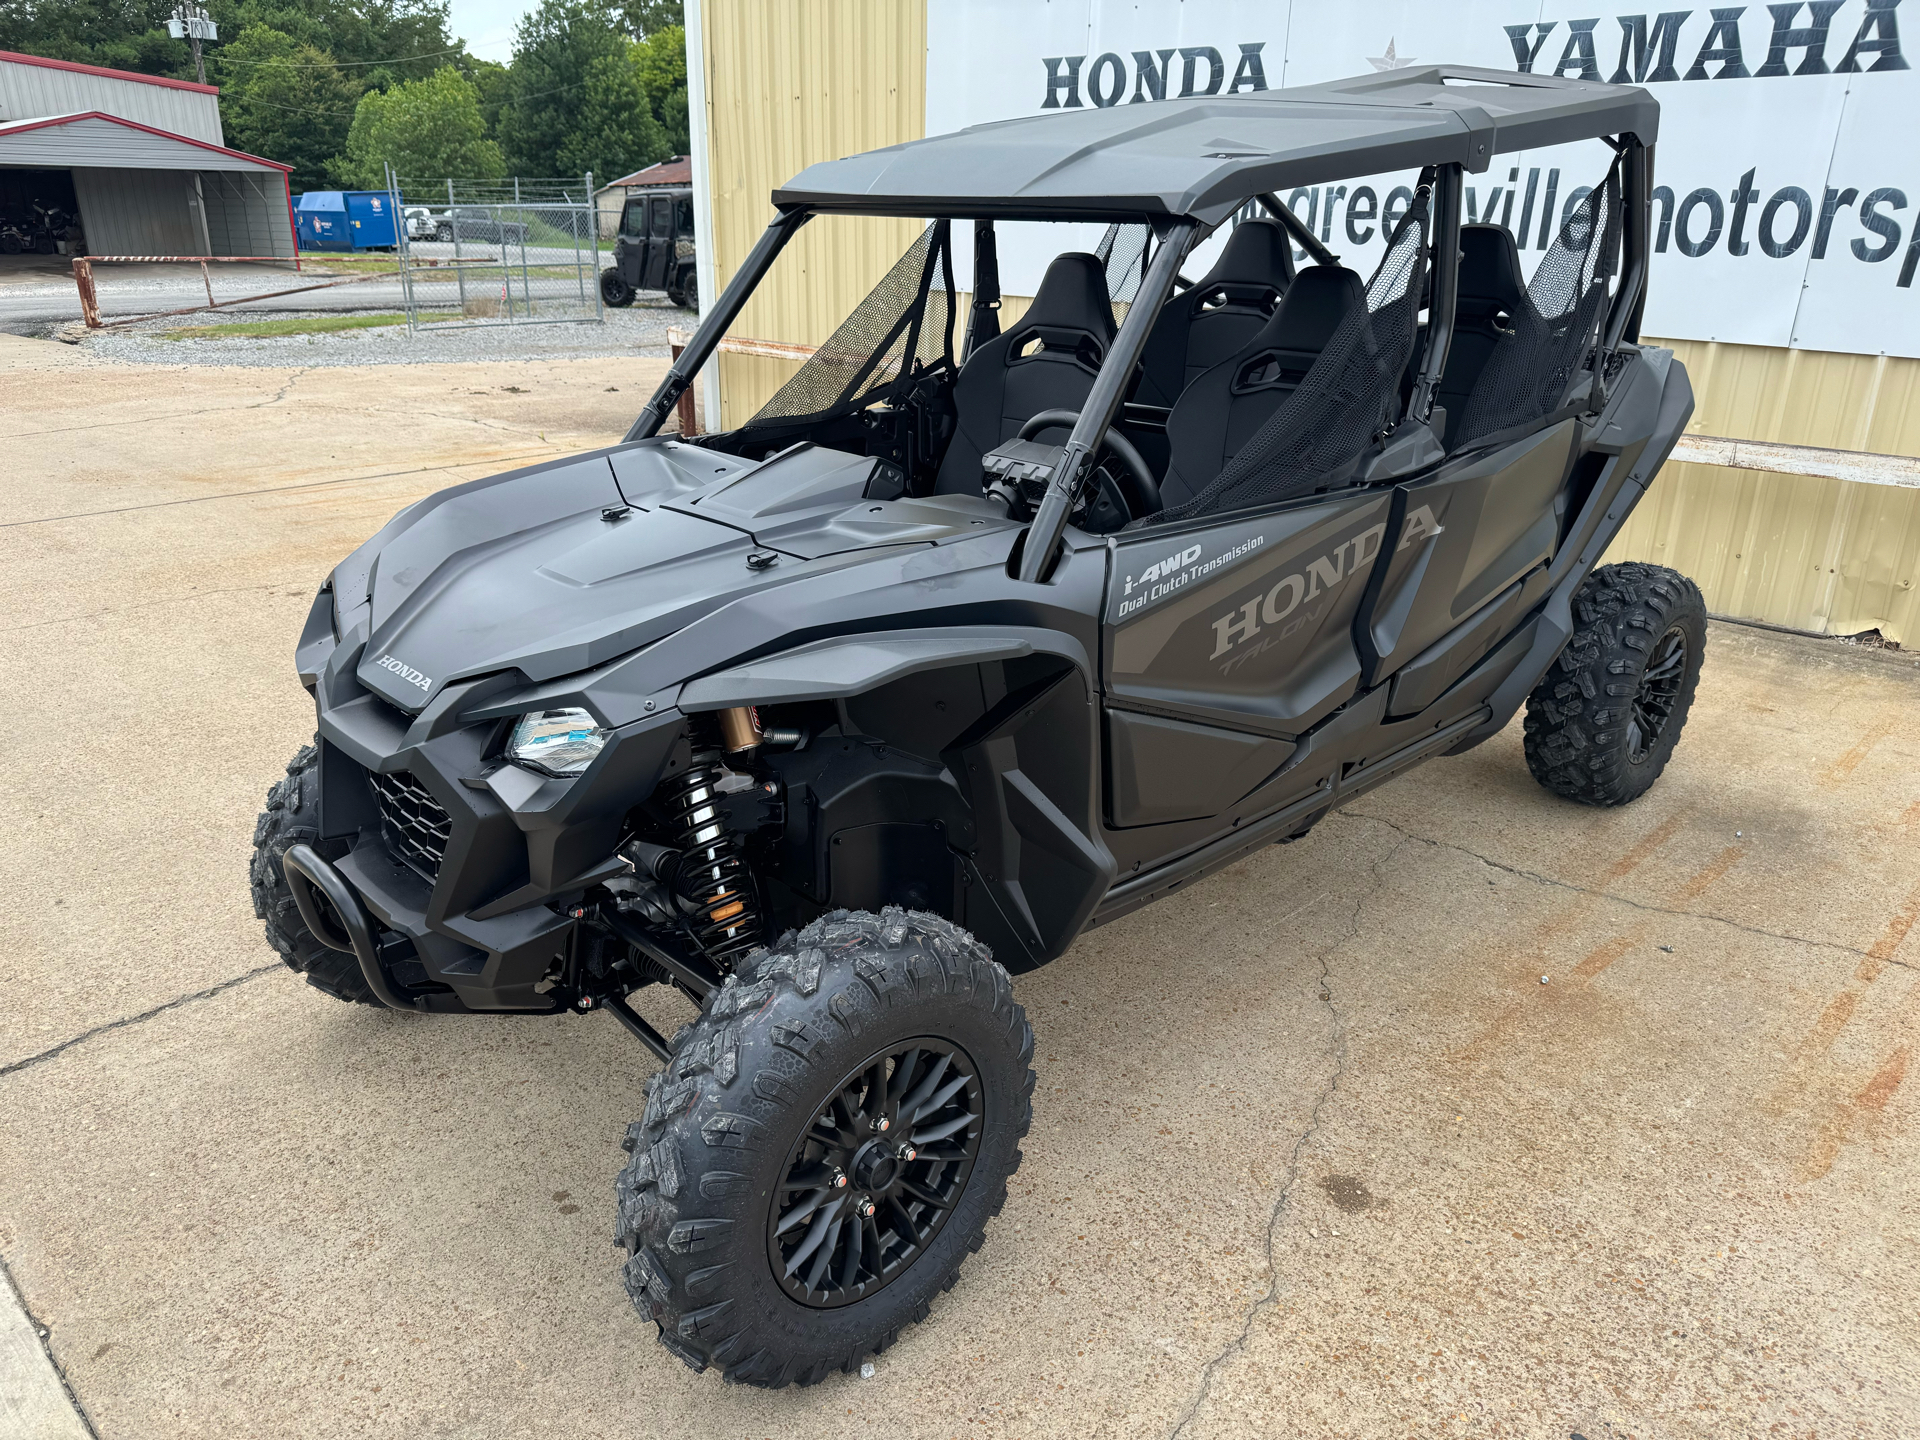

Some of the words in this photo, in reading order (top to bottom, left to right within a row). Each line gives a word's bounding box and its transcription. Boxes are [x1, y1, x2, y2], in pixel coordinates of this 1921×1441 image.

[1040, 42, 1270, 109] HONDA
[1502, 0, 1912, 84] YAMAHA
[1118, 591, 1147, 618] Dual
[1150, 571, 1188, 601] Clutch
[1189, 535, 1264, 580] Transmission
[1124, 543, 1202, 596] i-4WD
[1209, 504, 1445, 661] HONDA
[375, 654, 433, 692] HONDA
[1217, 600, 1325, 677] TALON
[931, 1120, 1008, 1264] KENDA
